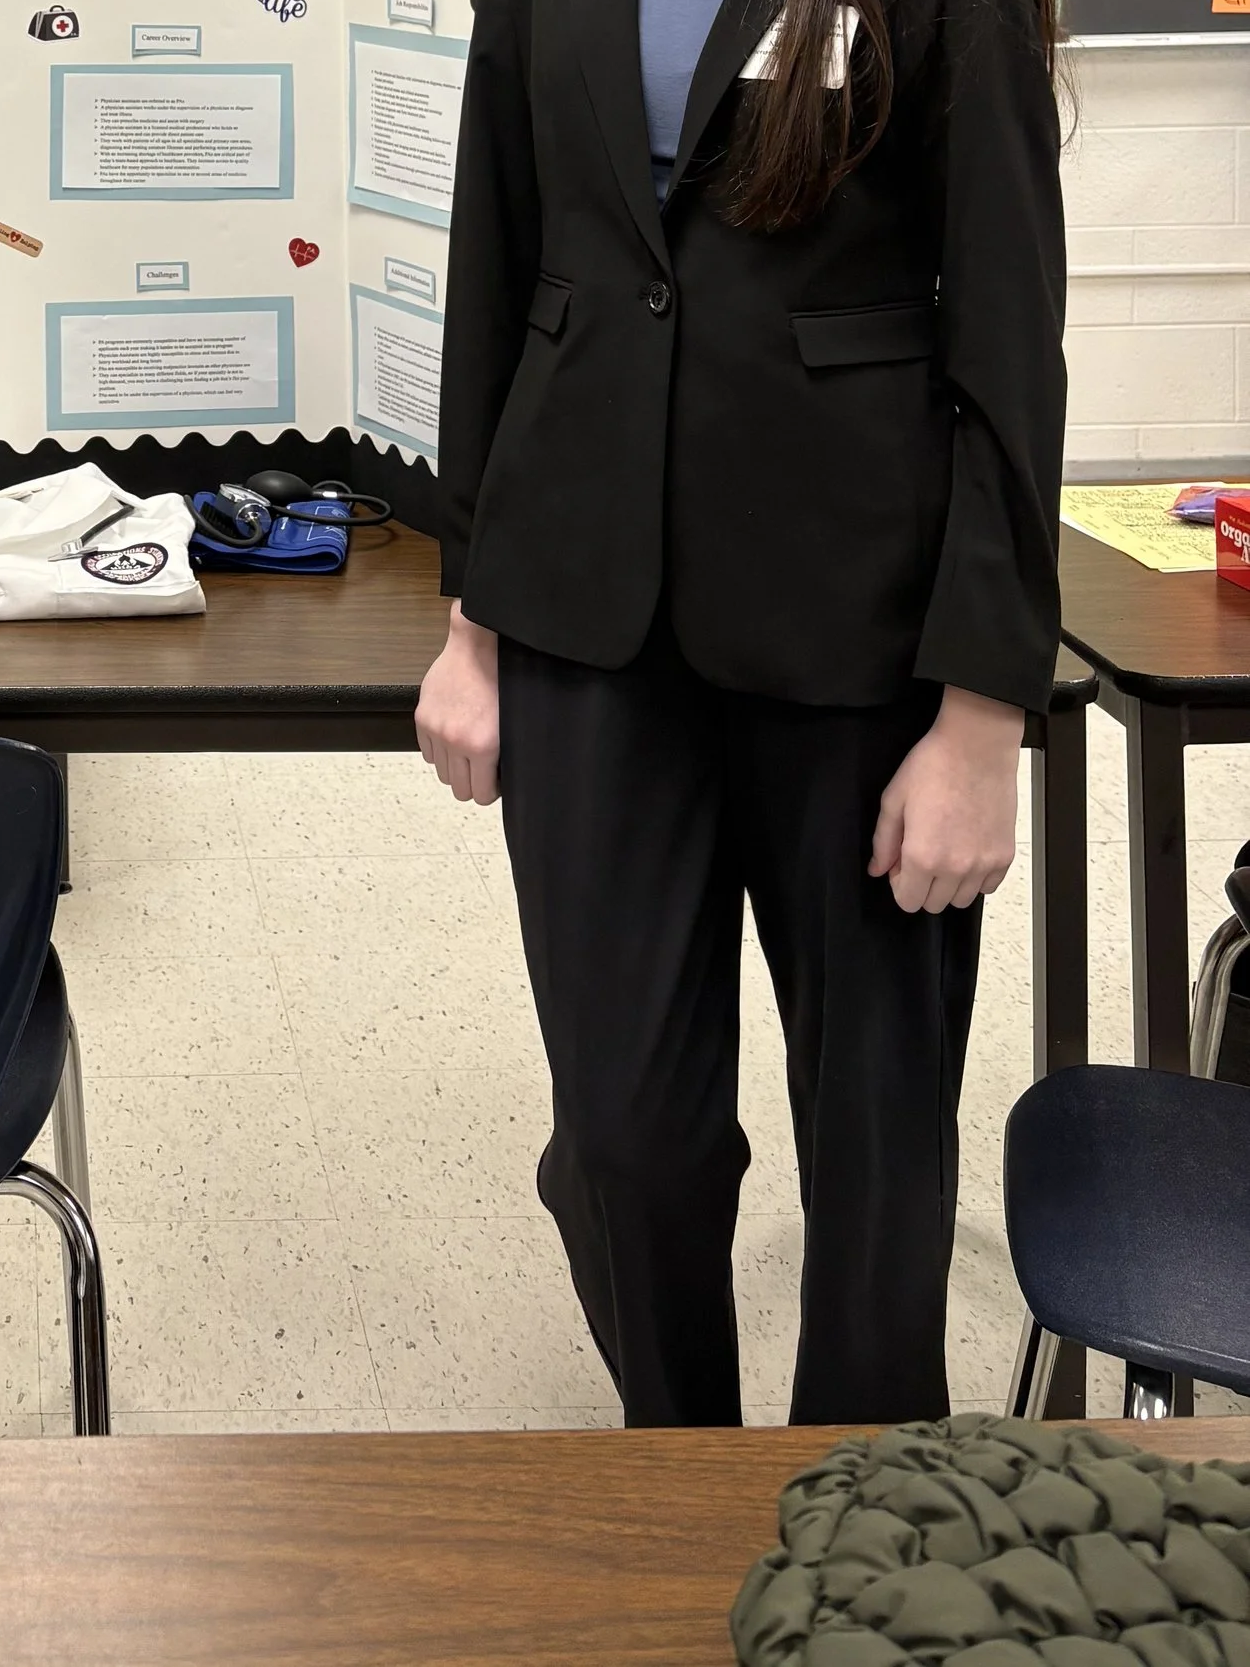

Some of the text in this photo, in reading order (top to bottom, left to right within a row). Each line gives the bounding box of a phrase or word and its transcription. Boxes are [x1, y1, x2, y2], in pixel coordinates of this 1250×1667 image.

[141, 34, 191, 42] Career Overview
[146, 270, 180, 280] Challenges
[1220, 520, 1250, 549] Orga
